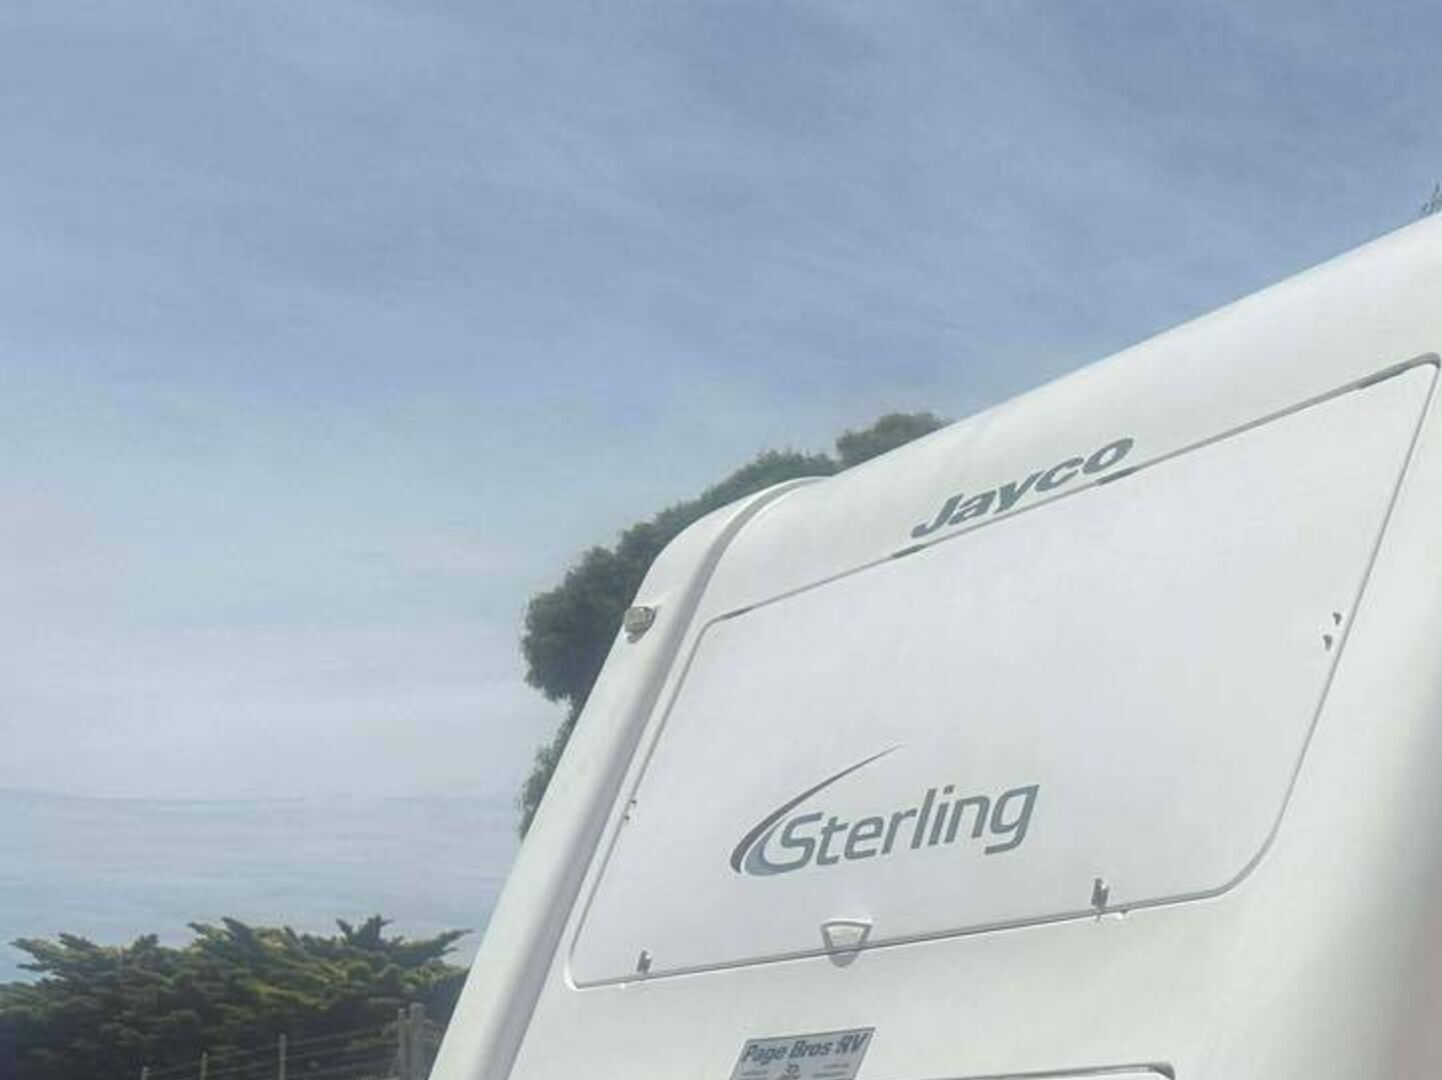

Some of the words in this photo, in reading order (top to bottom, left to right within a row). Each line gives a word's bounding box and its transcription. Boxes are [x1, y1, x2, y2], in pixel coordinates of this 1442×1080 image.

[911, 437, 1134, 539] Jayco
[744, 783, 1040, 877] Sterling
[788, 1039, 834, 1059] Bros
